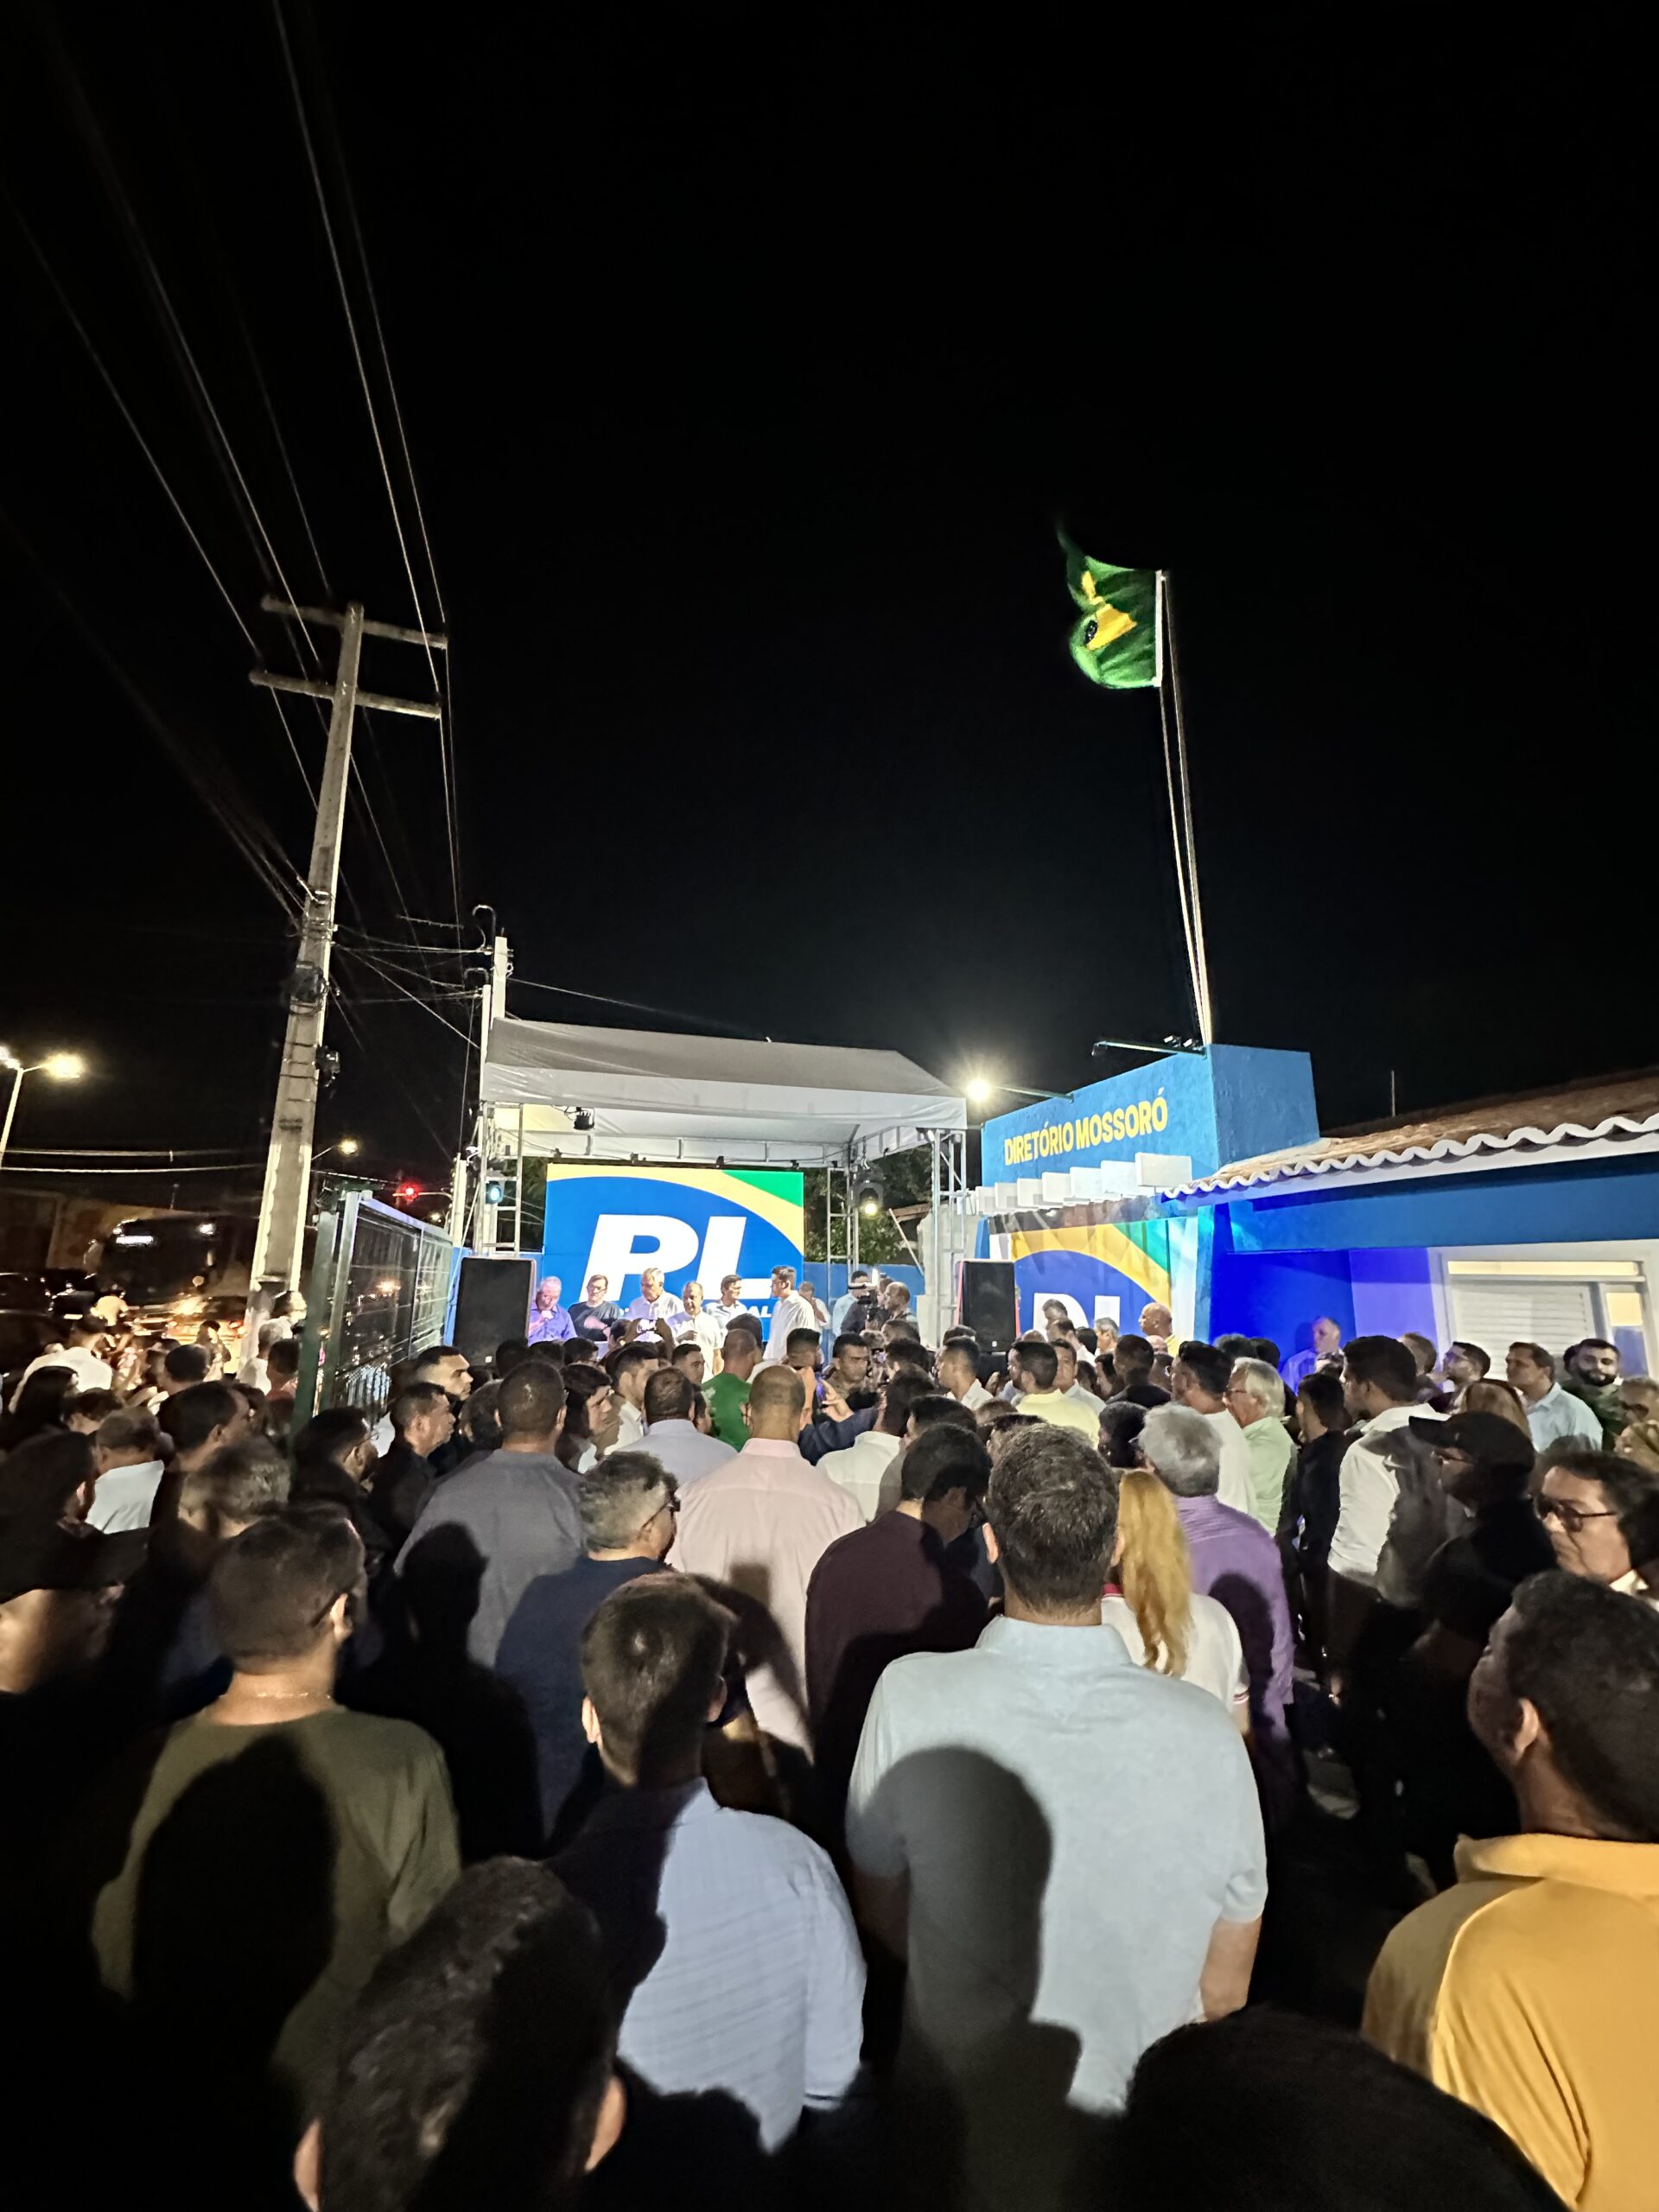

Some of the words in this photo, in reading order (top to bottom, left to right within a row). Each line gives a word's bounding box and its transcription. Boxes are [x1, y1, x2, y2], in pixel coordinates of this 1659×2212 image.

[1004, 1121, 1074, 1166] DIRETÓRIO
[1075, 1086, 1168, 1150] MOSSORÓ
[579, 1214, 773, 1302] PL
